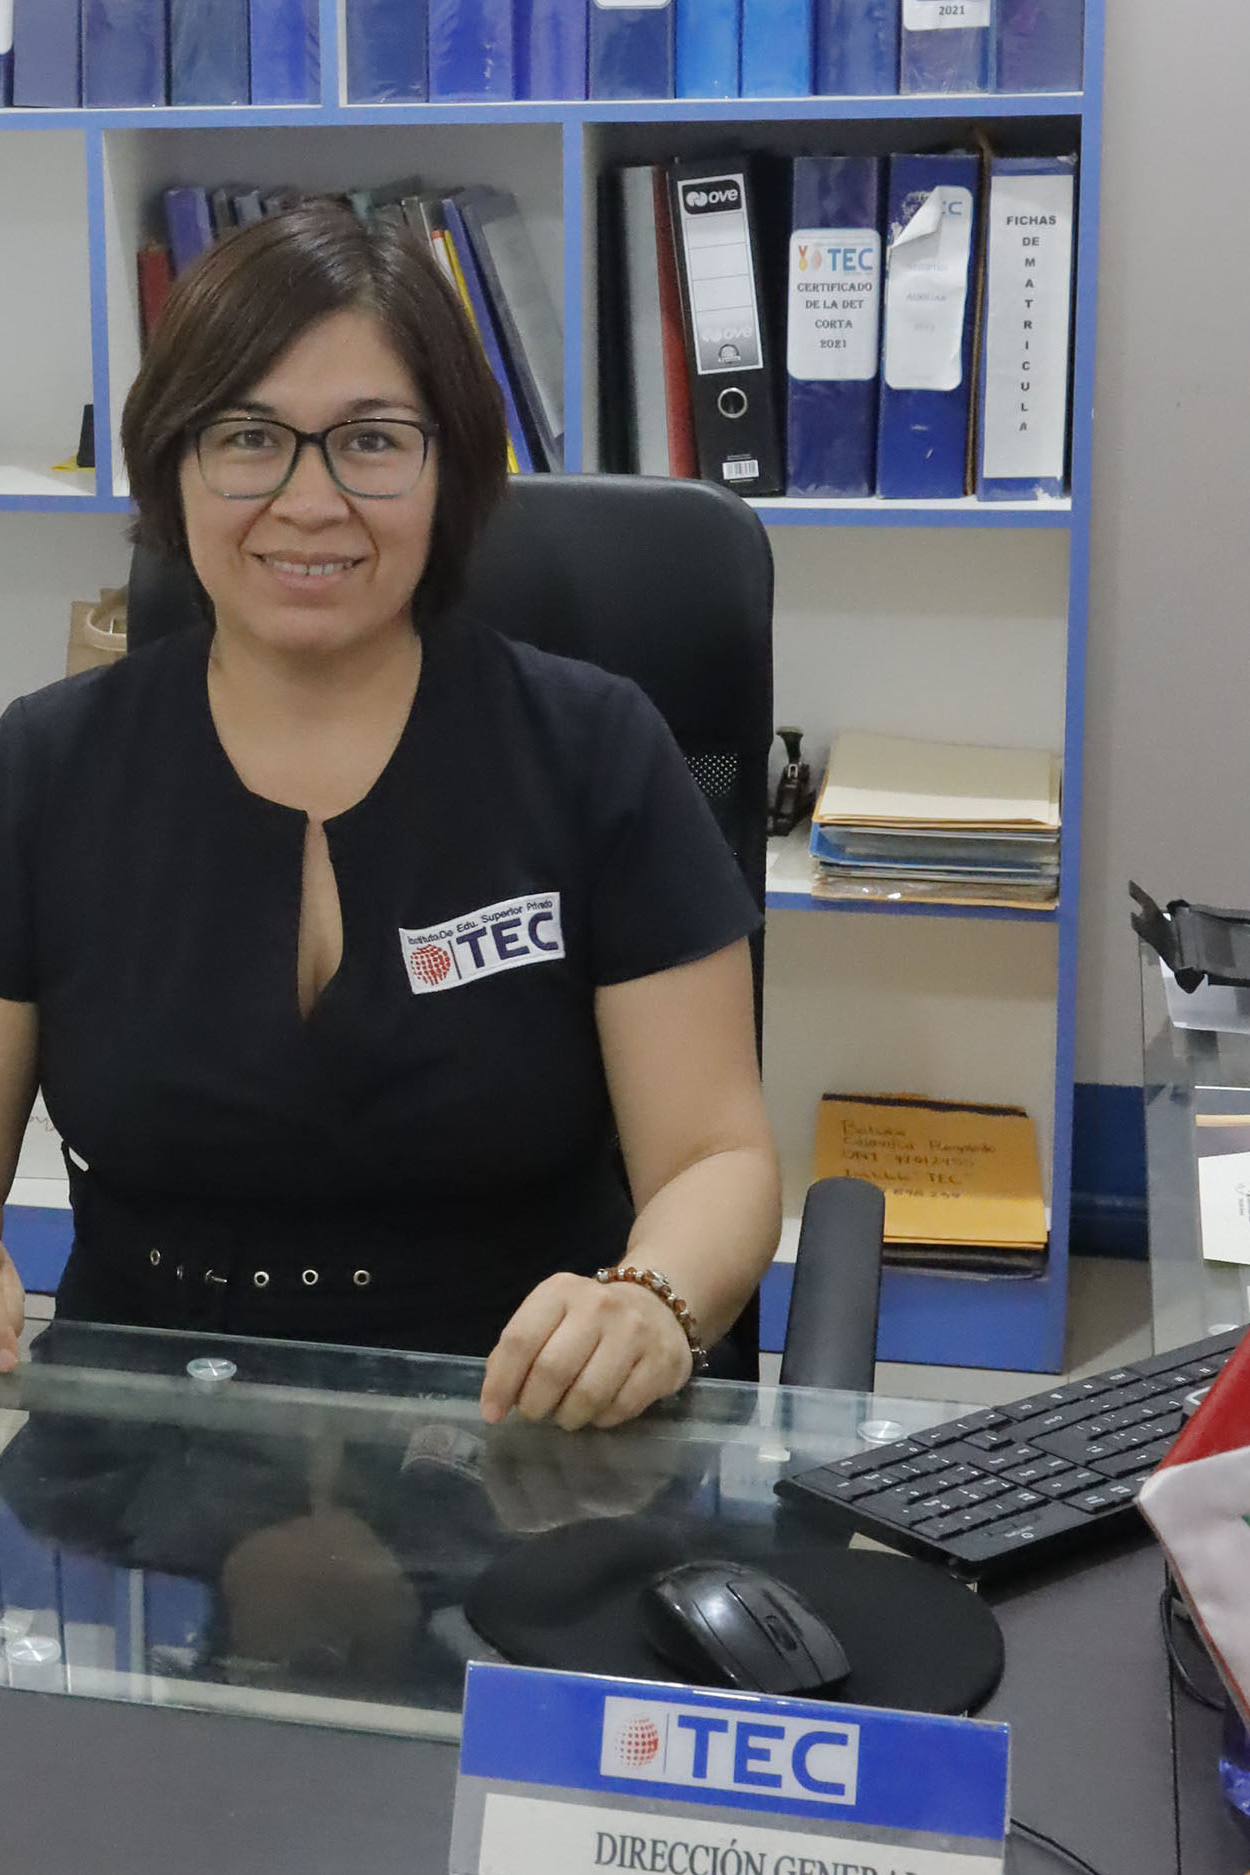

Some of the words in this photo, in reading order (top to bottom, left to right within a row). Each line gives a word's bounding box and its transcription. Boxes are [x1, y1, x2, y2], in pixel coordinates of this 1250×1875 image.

[939, 6, 966, 16] 2021
[709, 189, 739, 204] ove
[1006, 215, 1057, 226] FICHAS
[1022, 237, 1040, 247] DE
[827, 248, 873, 272] TEC
[797, 282, 872, 293] CERTIFICADO
[805, 300, 820, 310] DE
[823, 300, 839, 310] LA
[842, 300, 865, 310] DET
[814, 319, 853, 329] CORTA
[820, 339, 847, 349] 2021
[456, 921, 479, 933] Edu.
[481, 905, 523, 923] Superior
[456, 911, 559, 969] TEC
[678, 1714, 849, 1796] TEC
[595, 1832, 767, 1875] DIRECCIÓN
